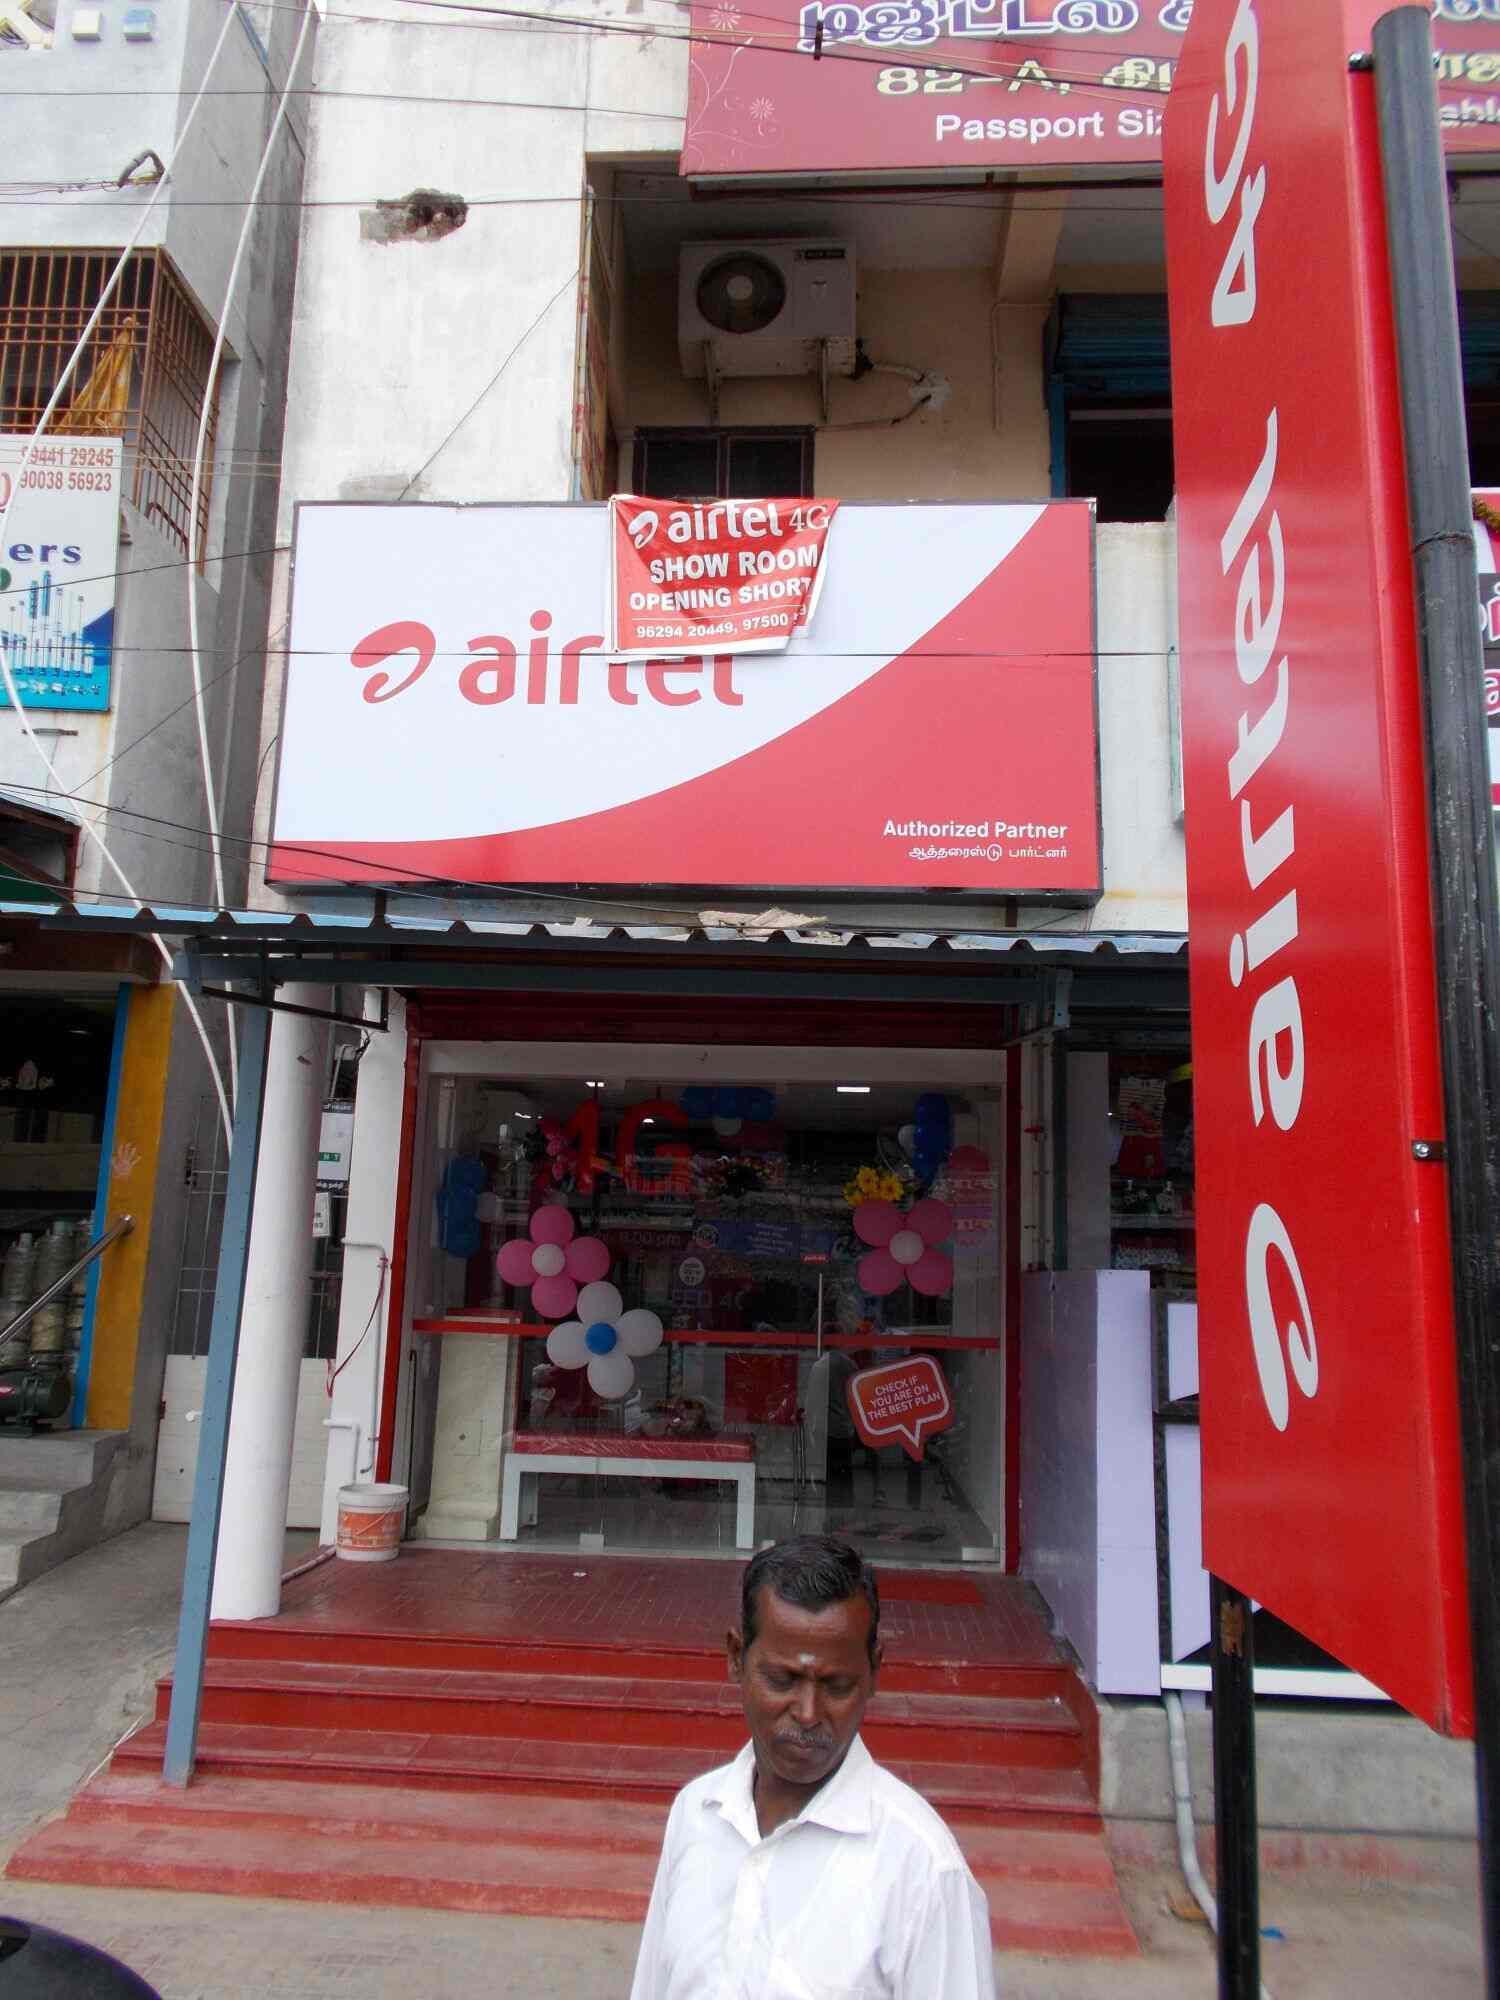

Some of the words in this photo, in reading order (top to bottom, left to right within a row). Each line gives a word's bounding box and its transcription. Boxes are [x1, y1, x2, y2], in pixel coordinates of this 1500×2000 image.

[935, 112, 1104, 144] Passport
[70, 447, 114, 467] 29245
[68, 472, 112, 492] 56923
[667, 501, 783, 543] airtel
[789, 504, 832, 533] 4G
[650, 552, 729, 584] SHOW
[739, 544, 818, 577] ROOM
[629, 586, 731, 612] OPENING
[635, 623, 683, 639] 96294
[742, 612, 788, 631] 97500
[1220, 405, 1304, 1131] airtel
[883, 819, 989, 838] Authorized
[994, 821, 1068, 839] Partner
[870, 1393, 893, 1409] YOU
[894, 1389, 913, 1403] ARE
[913, 1384, 928, 1395] ON
[874, 1379, 907, 1396] CHECK
[867, 1407, 888, 1422] THE
[888, 1401, 913, 1415] BEST
